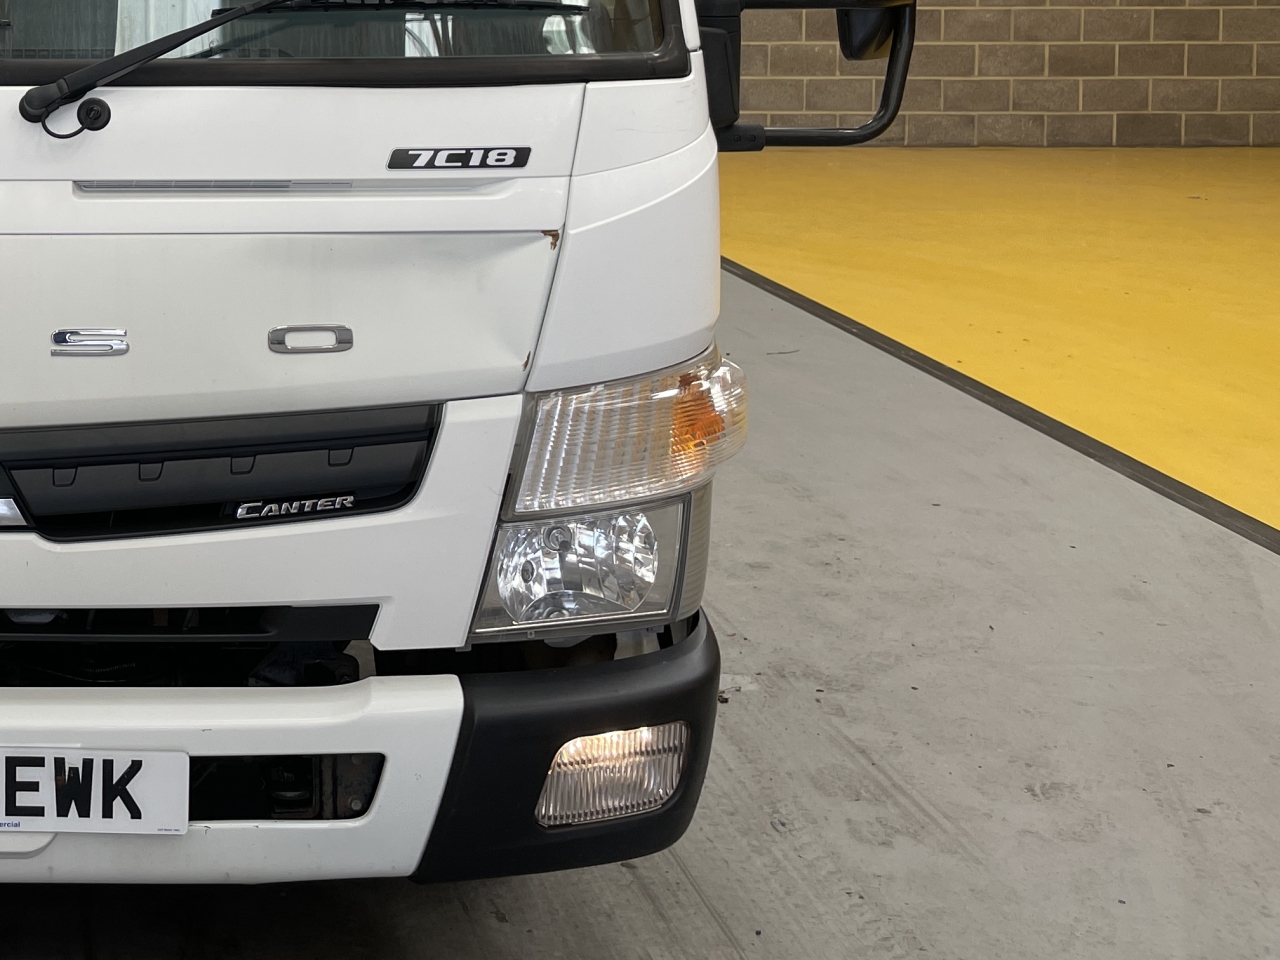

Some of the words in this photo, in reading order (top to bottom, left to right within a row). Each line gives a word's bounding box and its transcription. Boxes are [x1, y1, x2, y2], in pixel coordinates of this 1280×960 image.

[408, 149, 517, 167] 7C18
[236, 495, 354, 519] CANTER
[5, 756, 143, 820] EWK
